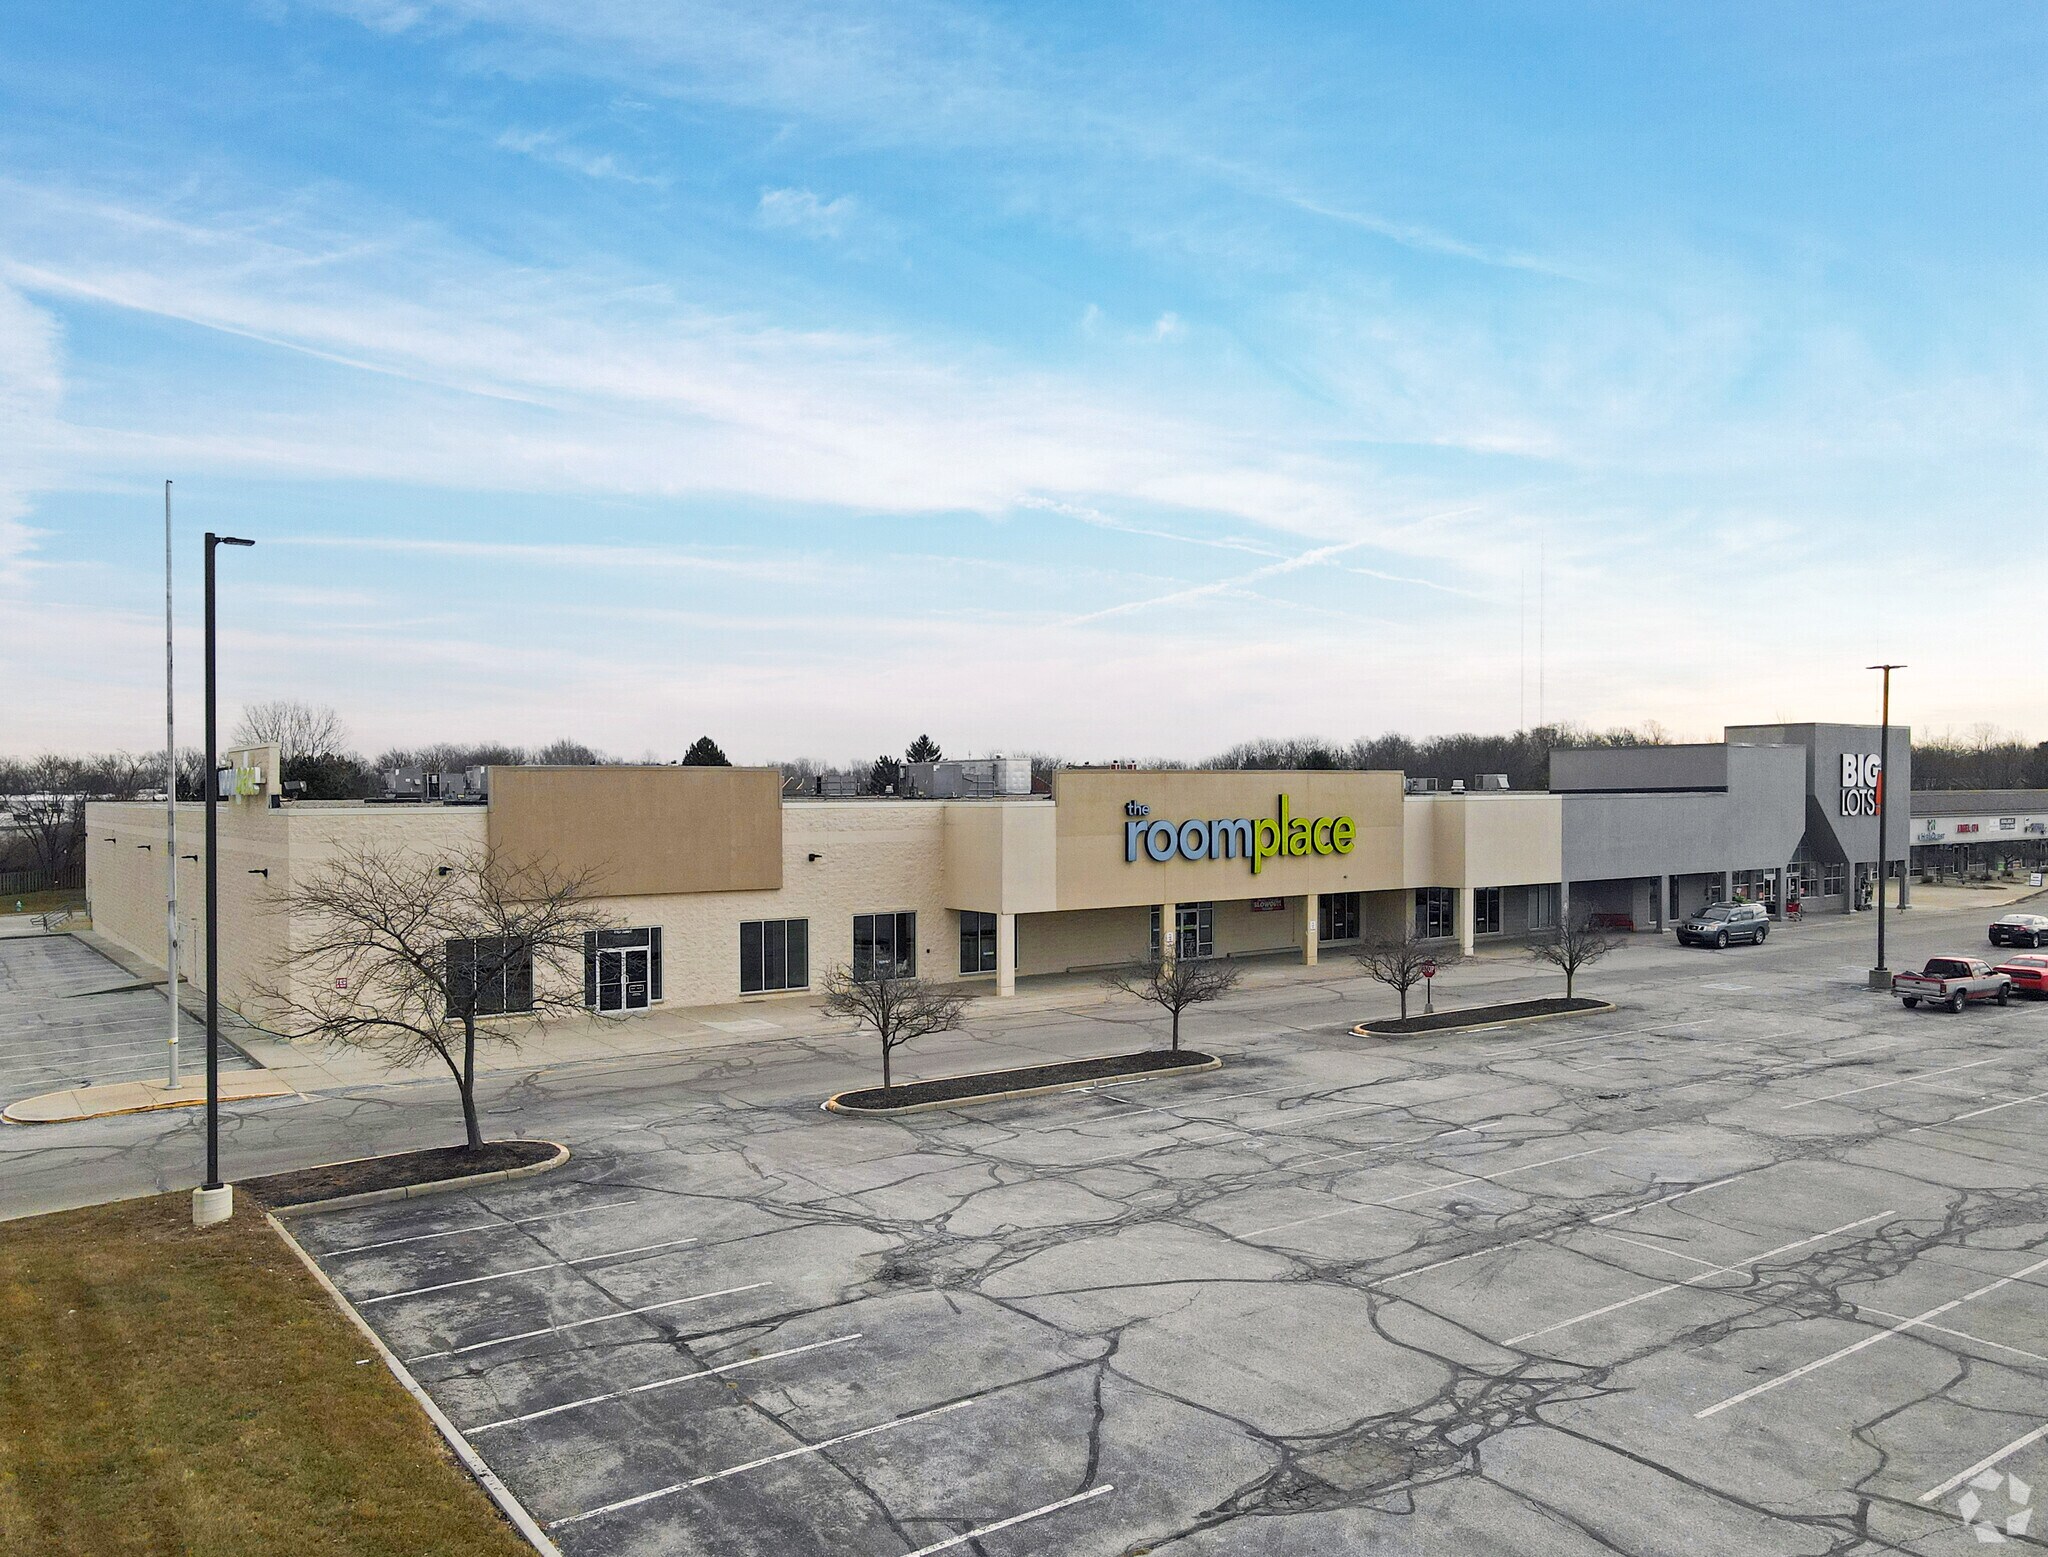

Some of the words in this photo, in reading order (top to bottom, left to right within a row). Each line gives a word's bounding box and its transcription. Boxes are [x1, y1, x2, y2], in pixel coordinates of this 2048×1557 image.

[1841, 754, 1882, 788] BIG
[1125, 800, 1151, 816] the
[1125, 794, 1357, 874] roomplace
[1422, 965, 1435, 973] STOP
